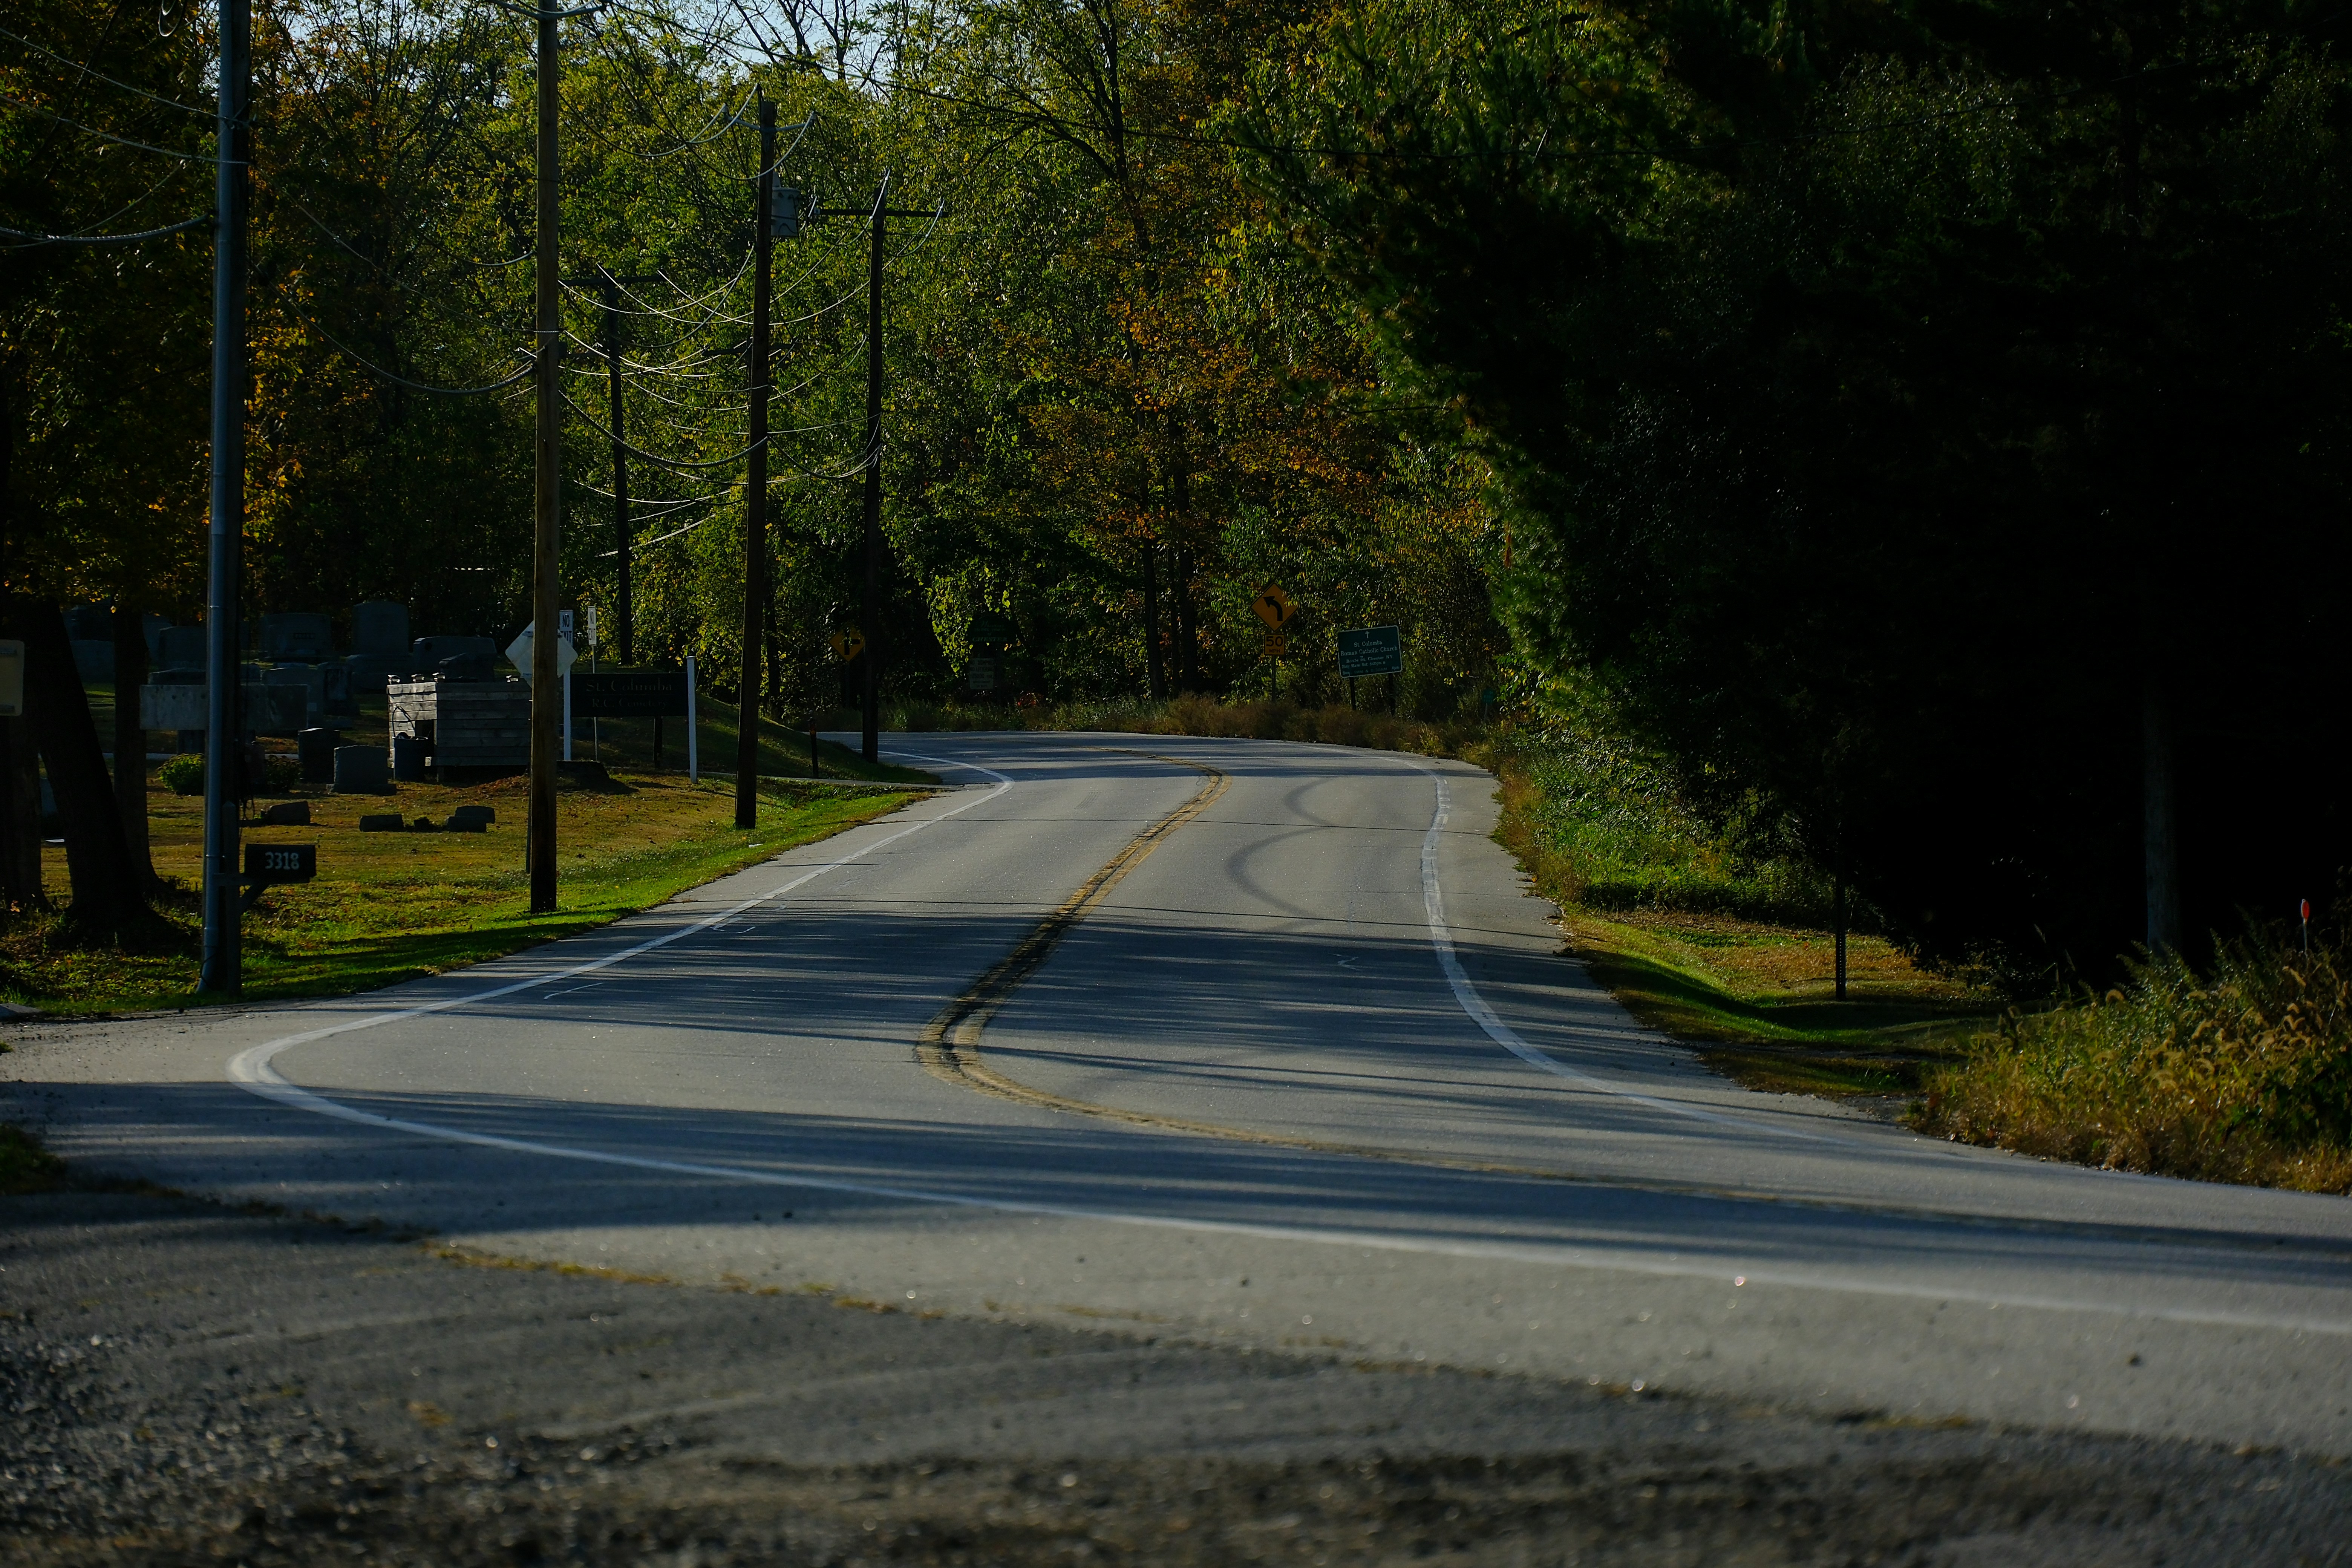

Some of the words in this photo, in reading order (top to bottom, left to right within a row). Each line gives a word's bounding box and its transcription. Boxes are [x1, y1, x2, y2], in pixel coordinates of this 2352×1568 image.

[562, 615, 570, 627] NO
[1266, 636, 1283, 646] 50
[586, 680, 605, 691] St.
[611, 678, 672, 691] Columba
[592, 698, 614, 707] R.C.
[619, 698, 667, 709] Cemetery
[265, 851, 300, 870] 3318
